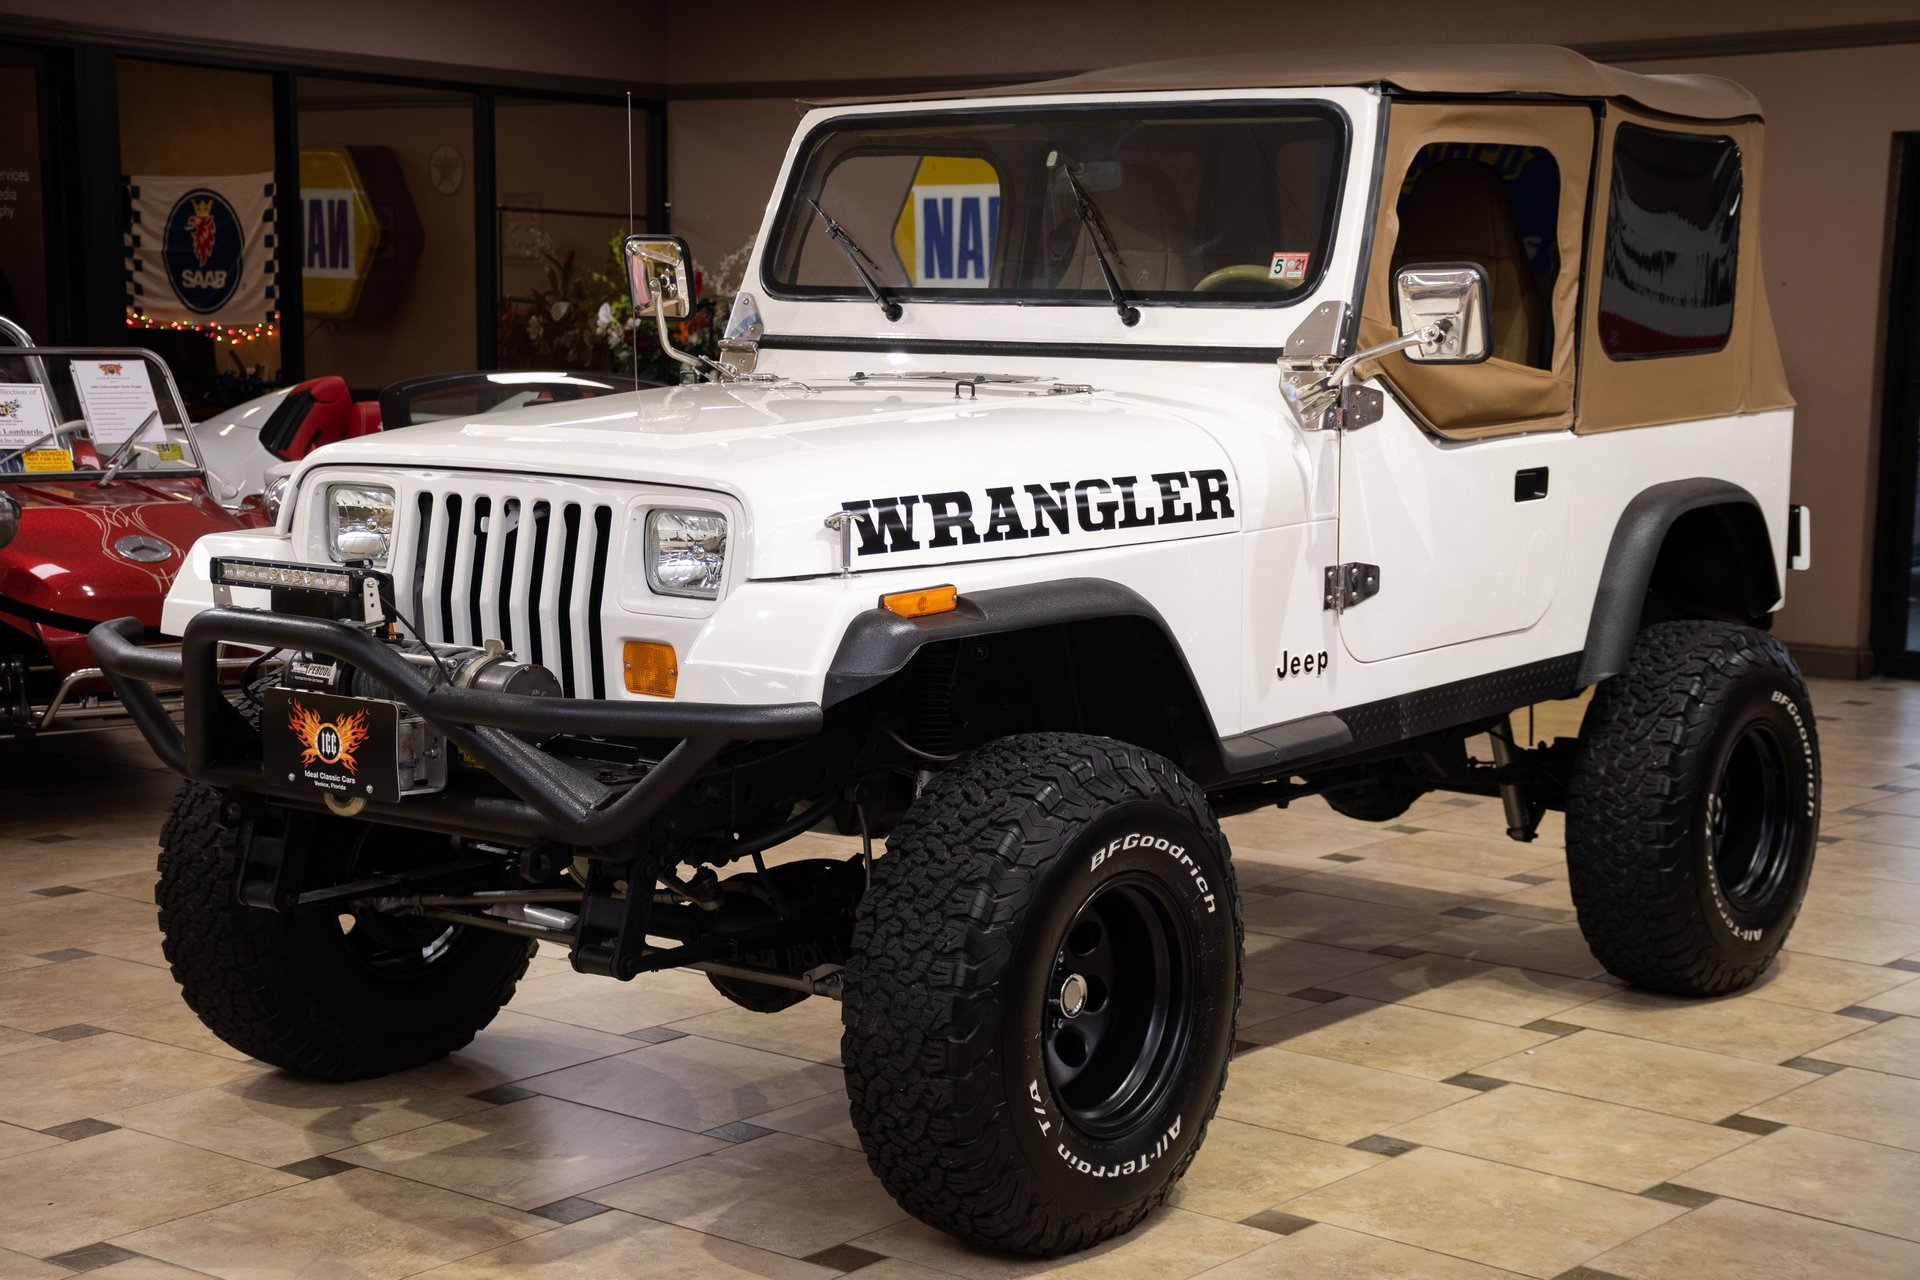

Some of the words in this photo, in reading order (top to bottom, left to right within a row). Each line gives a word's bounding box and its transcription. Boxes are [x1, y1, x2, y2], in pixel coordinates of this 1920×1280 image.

[181, 268, 228, 289] SAAB
[1274, 258, 1285, 274] 5
[1294, 258, 1306, 270] 21
[841, 468, 1235, 557] WRANGLER
[1277, 649, 1329, 680] Jeep
[304, 769, 319, 779] Ideal
[319, 772, 341, 782] Classic
[341, 775, 356, 785] Cars
[314, 780, 331, 789] Venice,
[331, 783, 347, 791] Florida
[1090, 833, 1217, 914] BFGoodrich
[1028, 1078, 1052, 1137] T/A
[1057, 1114, 1182, 1178] All-Terrain
